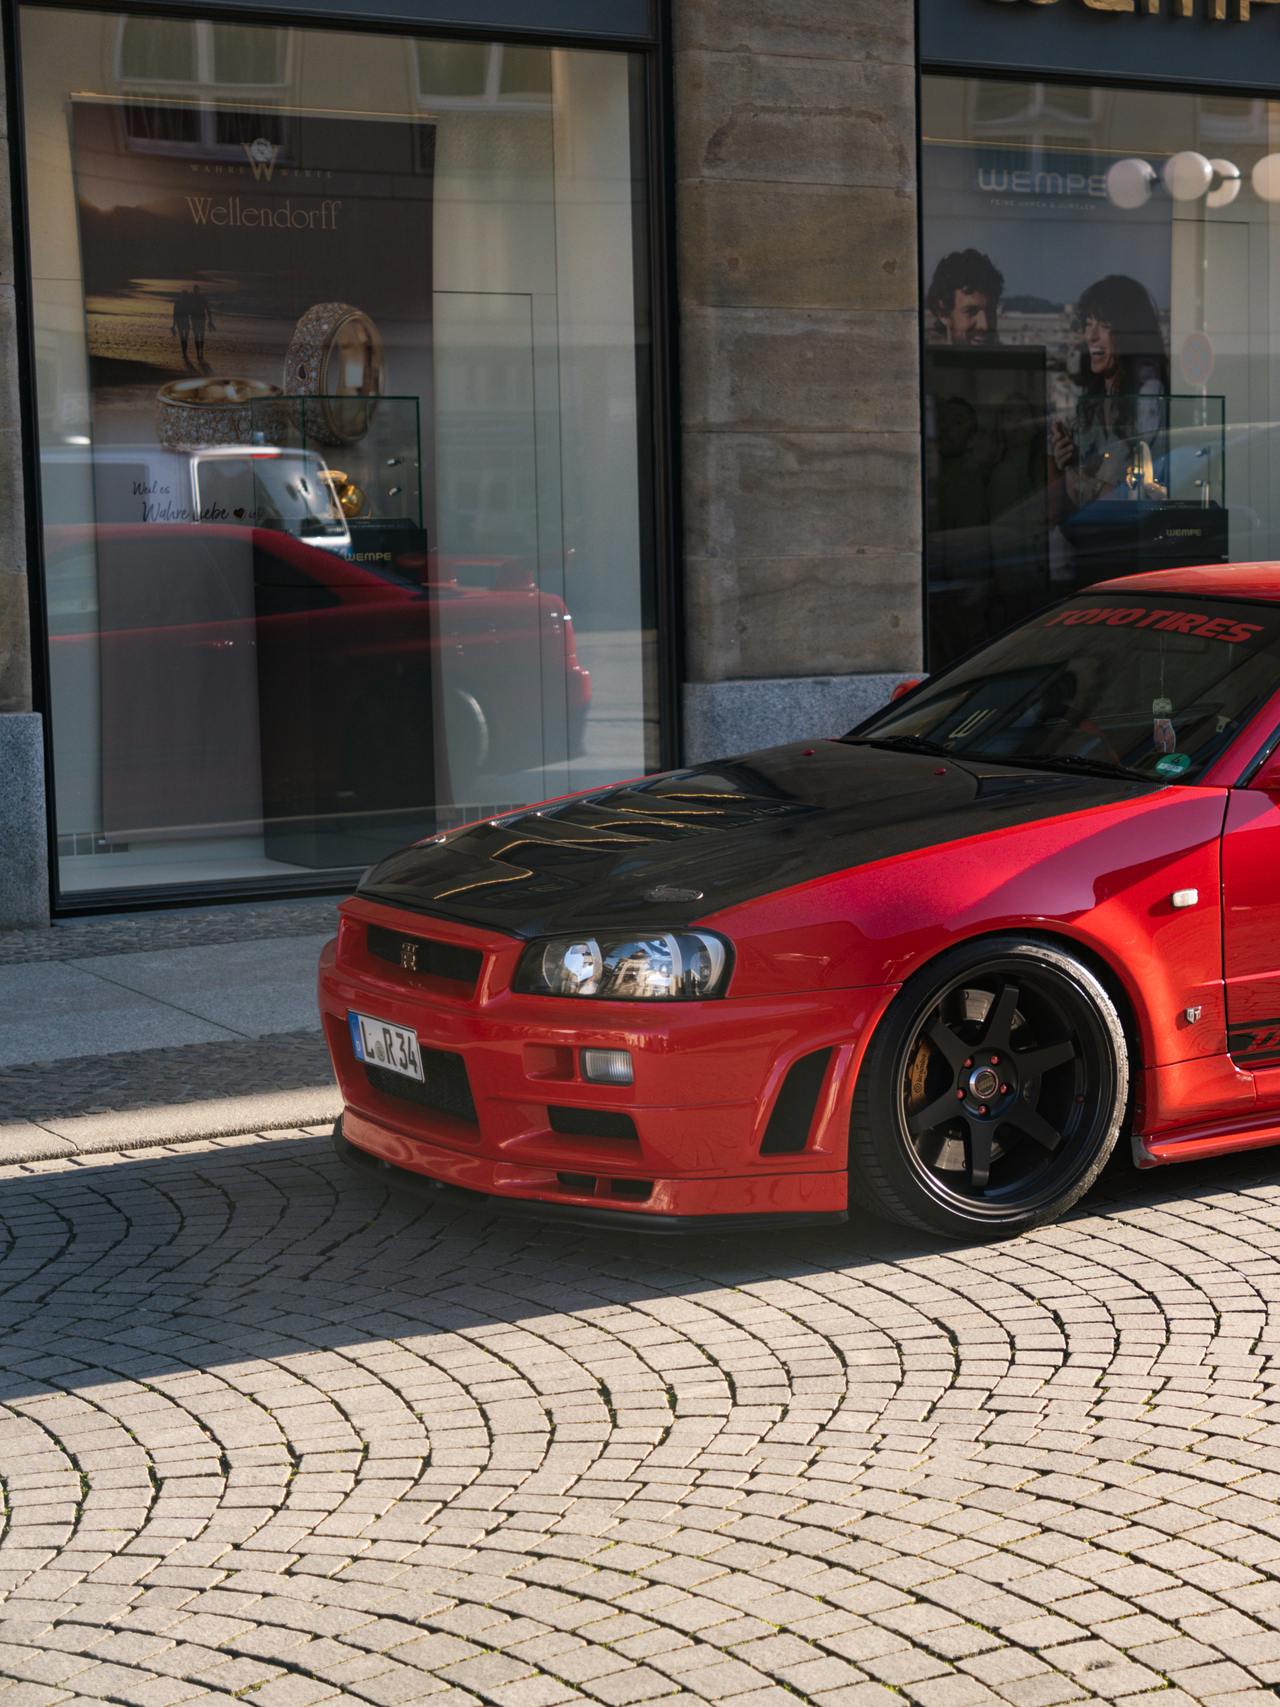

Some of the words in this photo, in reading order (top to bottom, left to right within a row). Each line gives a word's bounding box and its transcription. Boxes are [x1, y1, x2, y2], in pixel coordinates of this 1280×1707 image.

[190, 164, 246, 175] WAHRE
[280, 168, 333, 179] WERTE
[978, 168, 1107, 197] WEMPE
[990, 198, 1015, 206] FEINE
[185, 196, 342, 230] Wellendorff
[142, 501, 190, 522] Wahre
[1166, 528, 1202, 536] WEMPE
[344, 552, 392, 561] WEMPE
[361, 1020, 375, 1059] L
